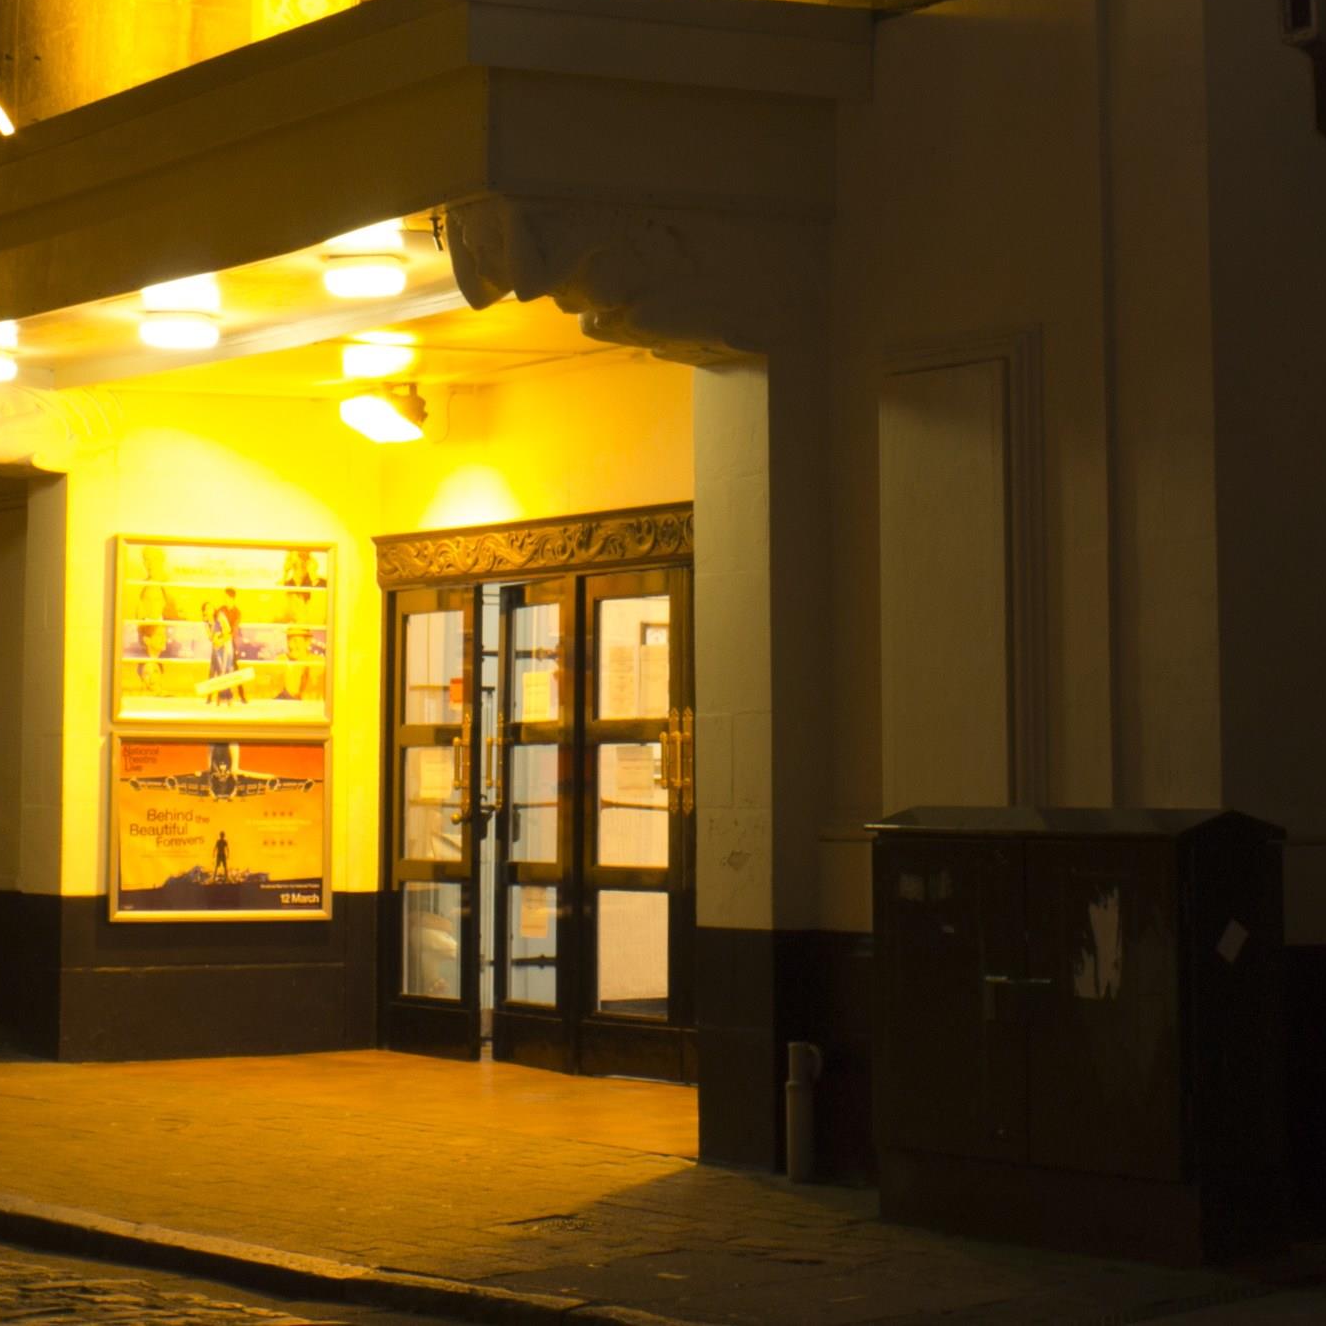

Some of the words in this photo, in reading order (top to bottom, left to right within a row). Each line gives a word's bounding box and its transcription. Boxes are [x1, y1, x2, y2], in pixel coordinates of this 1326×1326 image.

[123, 746, 160, 757] National
[124, 764, 143, 772] Live
[146, 807, 194, 822] Behind
[195, 814, 211, 824] the
[129, 822, 188, 836] Beautiful
[155, 835, 205, 848] Forevers
[279, 892, 291, 905] 12
[291, 892, 320, 905] March
